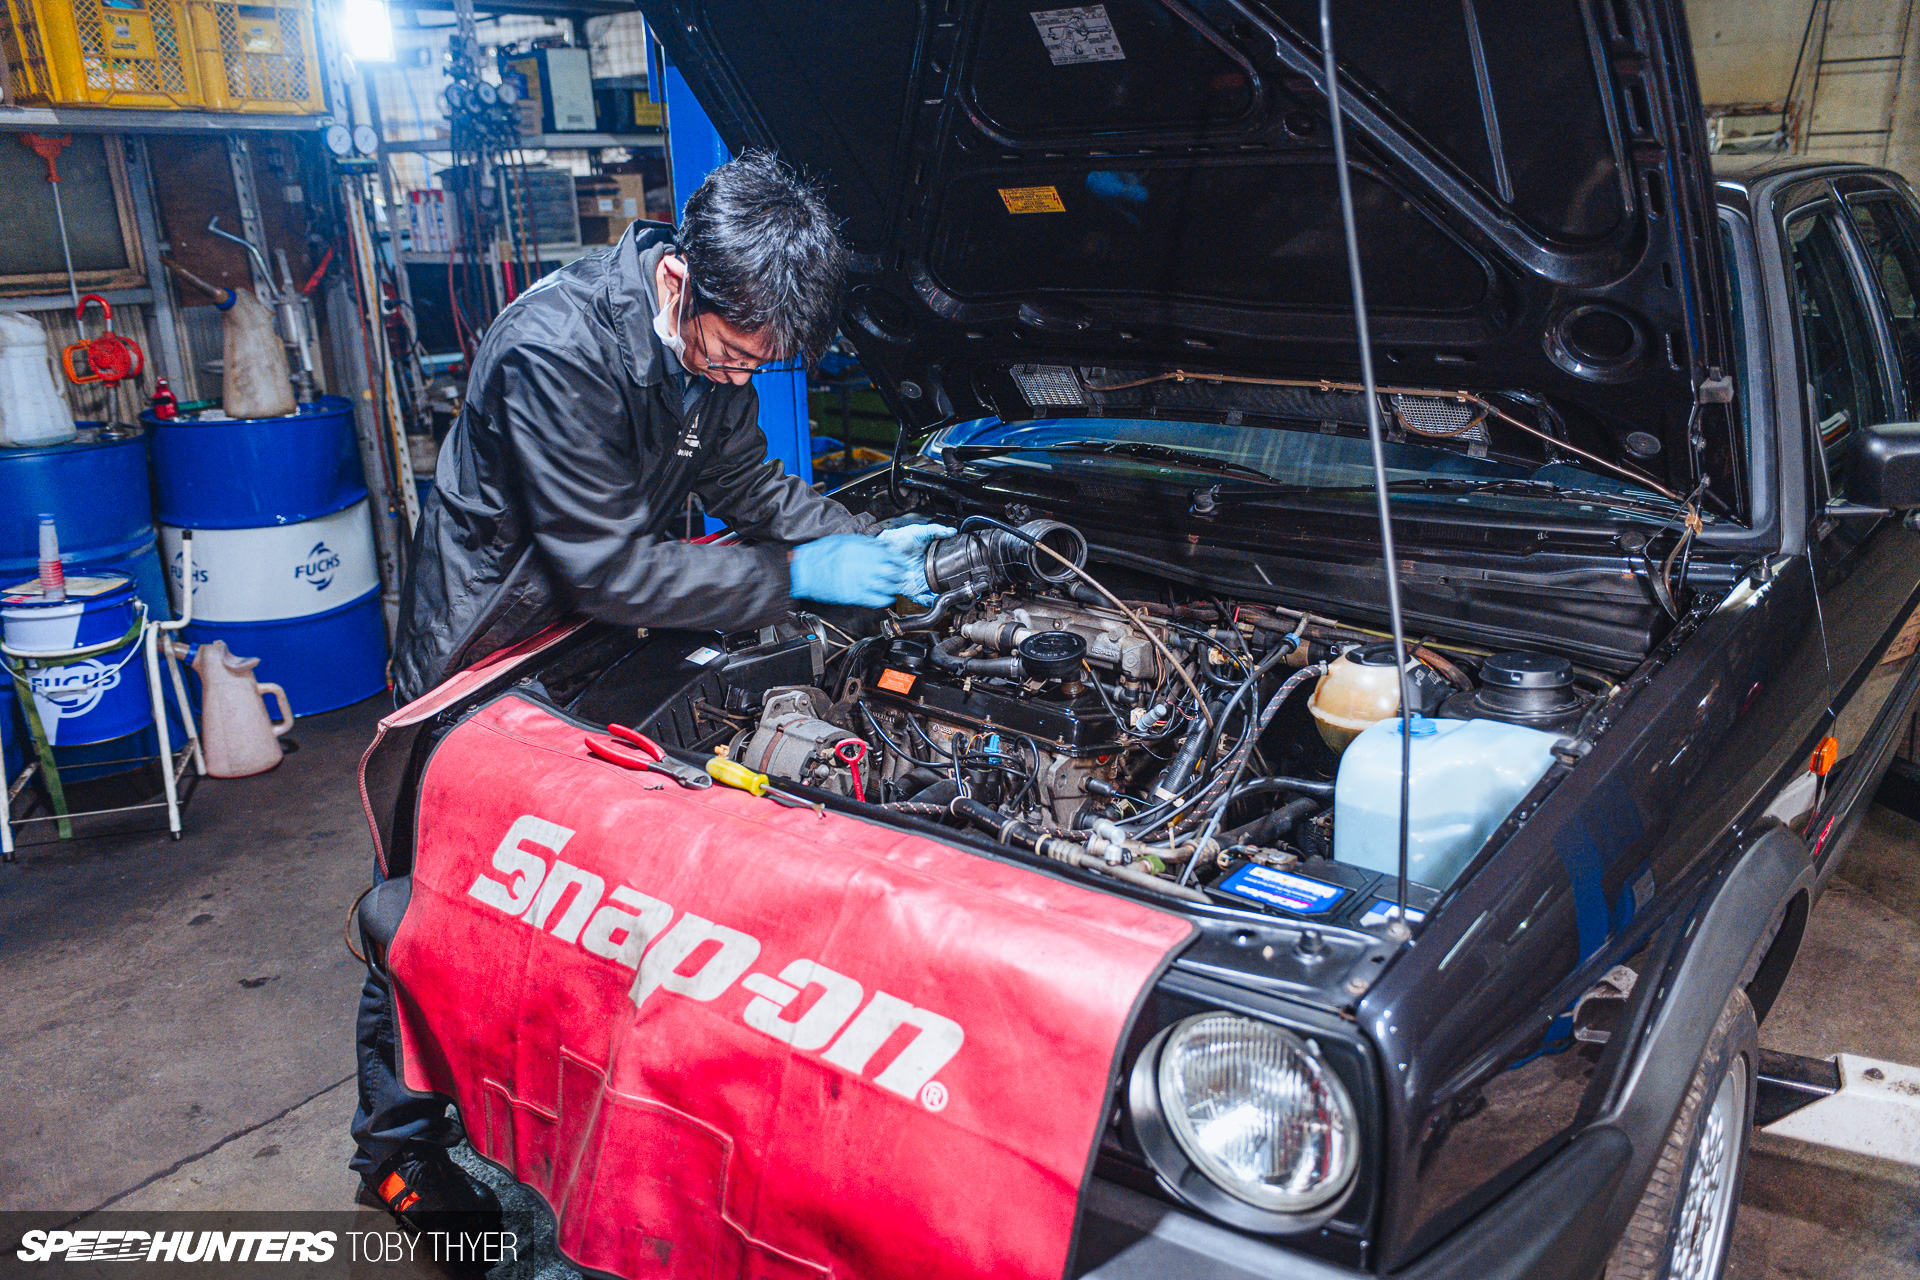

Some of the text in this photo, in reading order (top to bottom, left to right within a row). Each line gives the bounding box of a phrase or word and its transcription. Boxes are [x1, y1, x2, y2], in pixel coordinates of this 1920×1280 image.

[170, 565, 209, 583] FUHS
[294, 553, 341, 579] FUCHS
[467, 814, 965, 1101] Snap-on
